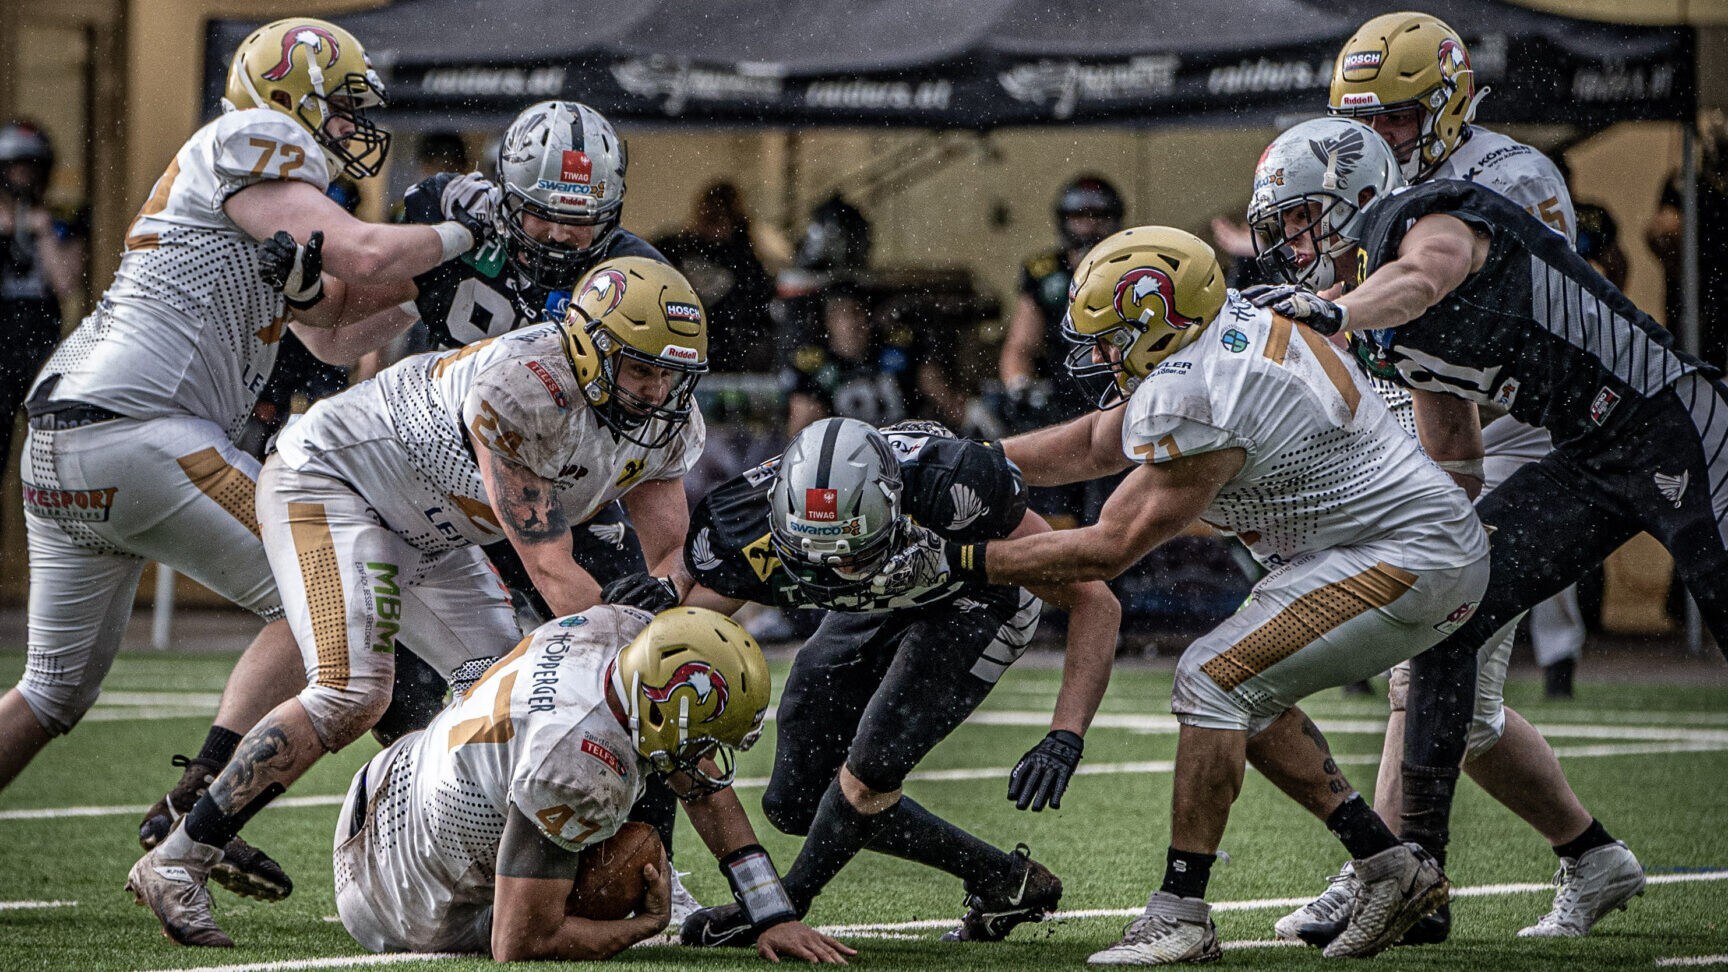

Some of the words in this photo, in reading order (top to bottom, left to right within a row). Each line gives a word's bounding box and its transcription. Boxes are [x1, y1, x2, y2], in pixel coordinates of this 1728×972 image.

[1343, 95, 1373, 105] Riddell
[249, 137, 306, 182] 72
[537, 179, 591, 194] swarco
[560, 195, 587, 206] Riddell
[667, 304, 701, 319] HOSCH
[668, 347, 697, 360] Riddell
[531, 363, 558, 392] TELFS
[1133, 432, 1183, 465] 71
[808, 510, 835, 519] TIWAG
[790, 521, 842, 536] swarco
[366, 562, 401, 653] MBM
[587, 741, 616, 766] TELFS
[534, 803, 602, 844] 47
